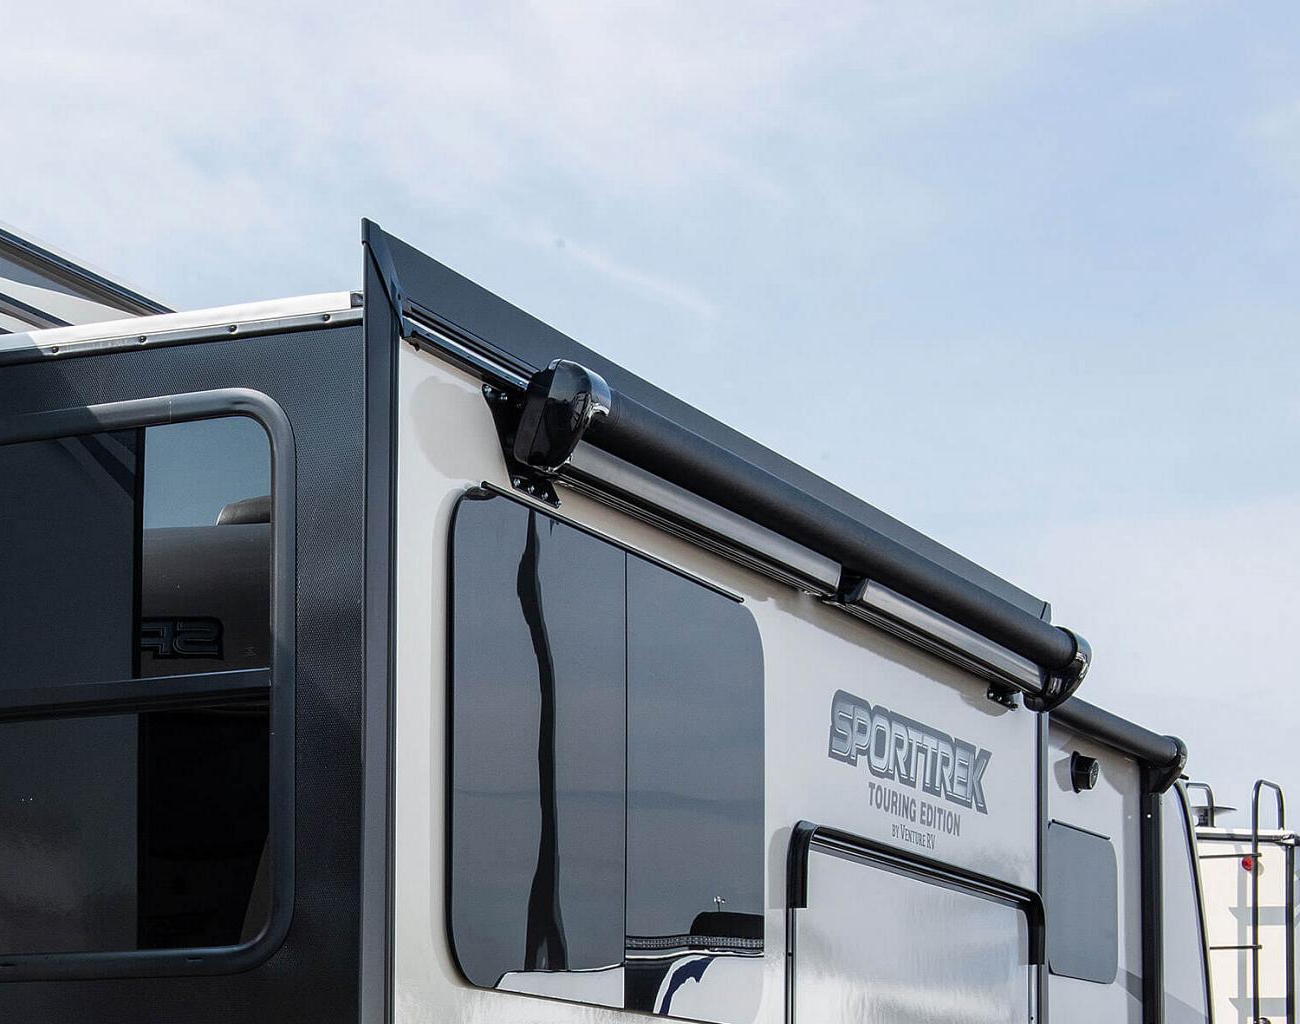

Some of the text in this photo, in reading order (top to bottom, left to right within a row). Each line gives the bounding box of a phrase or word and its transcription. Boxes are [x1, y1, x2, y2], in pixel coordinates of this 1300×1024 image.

[828, 689, 992, 815] SPORTTREK
[868, 781, 961, 837] TOURING EDITION
[892, 824, 900, 838] BY
[926, 833, 936, 849] RV
